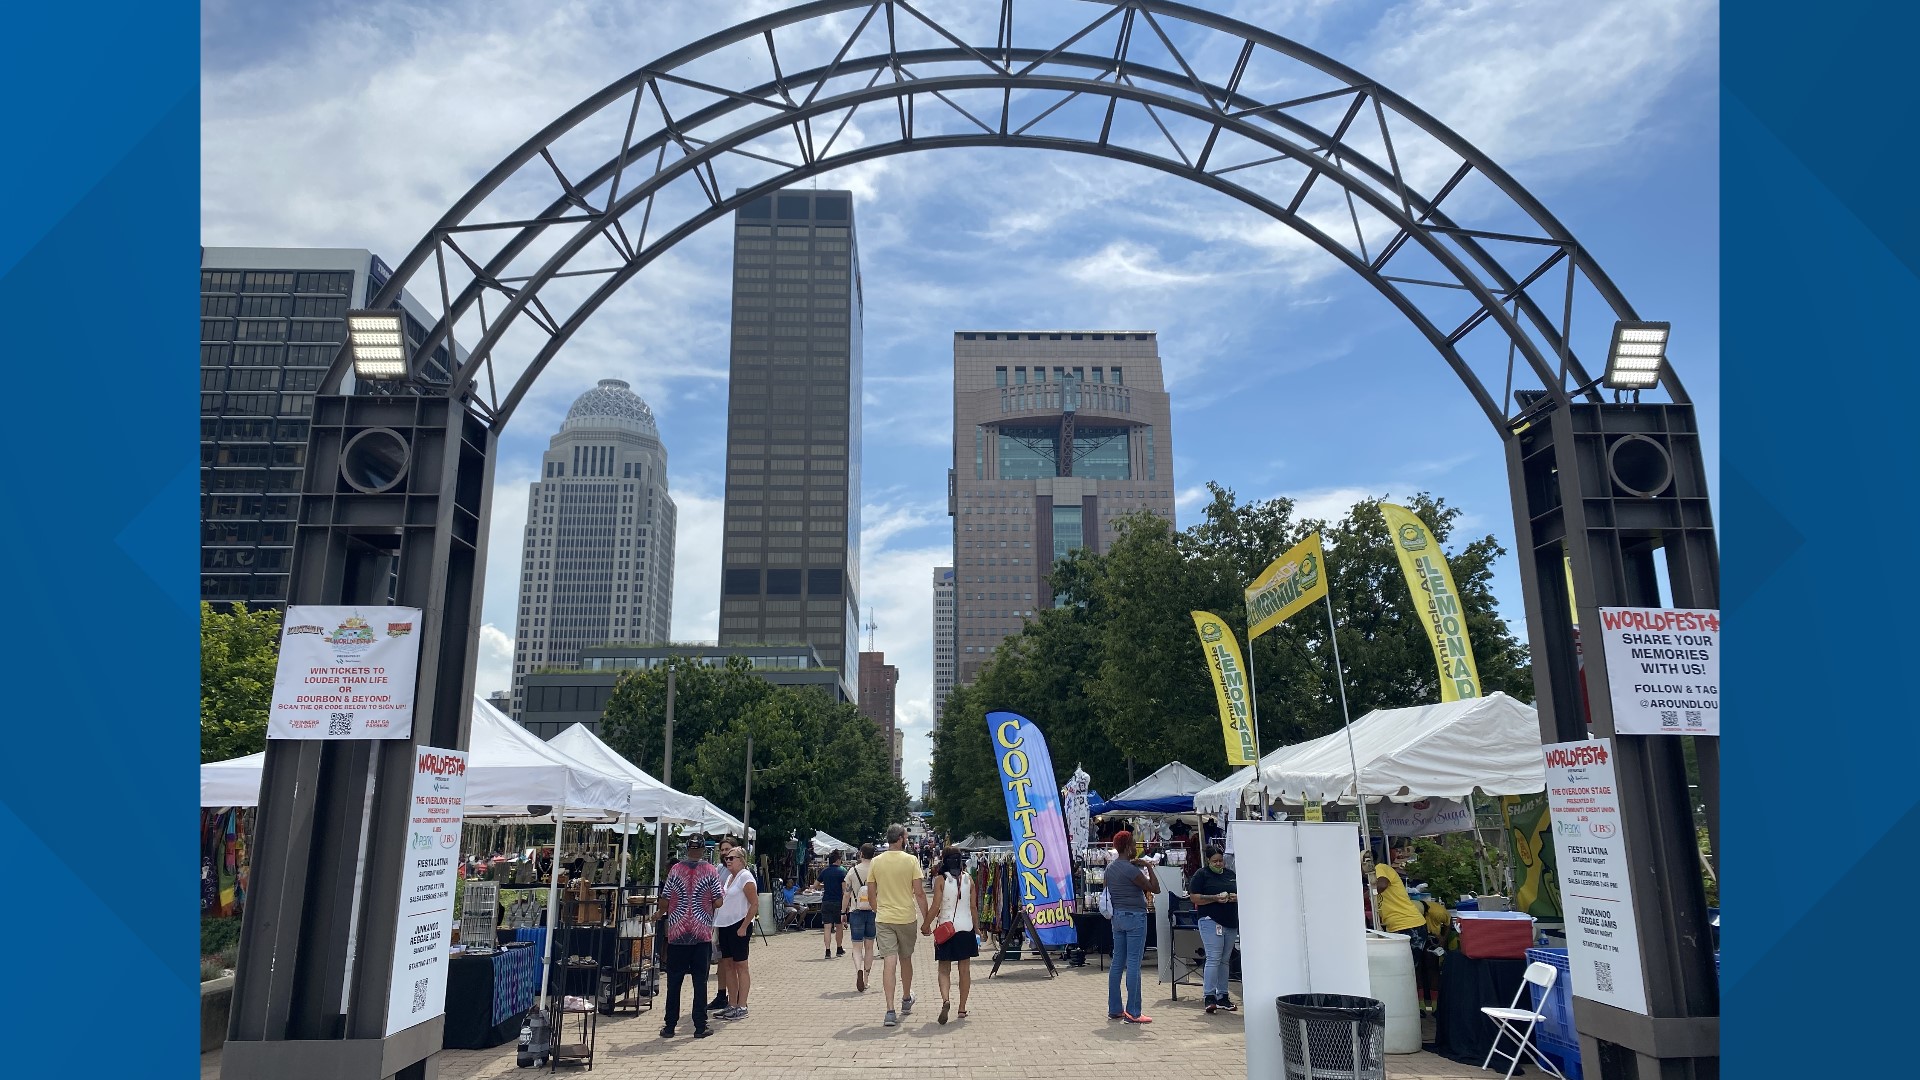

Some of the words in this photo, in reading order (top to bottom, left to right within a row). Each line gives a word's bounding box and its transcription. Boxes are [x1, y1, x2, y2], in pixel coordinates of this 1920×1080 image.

[1602, 610, 1706, 632] WORLDFEST
[1622, 633, 1672, 645] SHARE
[1674, 634, 1714, 646] YOUR
[1631, 648, 1709, 660] MEMORIES
[310, 667, 328, 675] WIN
[329, 667, 370, 675] TICKETS
[372, 667, 385, 675] TO
[1641, 662, 1679, 674] WITH
[1681, 663, 1706, 675] US!
[304, 676, 340, 684] LOUDER
[342, 676, 367, 684] THAN
[369, 676, 388, 684] LIFE
[1634, 684, 1683, 693] FOLLOW
[1686, 685, 1693, 694] &
[1695, 685, 1718, 694] TAG
[296, 695, 342, 703] BOURBON
[351, 695, 391, 703] BEYOND!
[1217, 644, 1256, 761] LEMONADE
[1545, 745, 1599, 768] WORLDFEST
[418, 753, 460, 776] WORLDFEST
[1562, 787, 1590, 795] OVERLOOK
[1591, 786, 1611, 795] STAGE
[416, 796, 425, 805] THE
[425, 797, 448, 805] OVERLOOK
[997, 719, 1049, 900] COTTON
[1507, 800, 1535, 816] SHAKE
[1593, 824, 1611, 832] JBS
[442, 834, 455, 843] JBS
[1567, 845, 1587, 855] FIESTA
[1587, 847, 1609, 855] LATINA
[417, 858, 433, 868] FIESTA
[1573, 869, 1592, 877] STARTING
[1580, 879, 1599, 887] LESSONS
[1025, 899, 1074, 928] Candy
[1581, 907, 1611, 919] JUNKANOO
[414, 921, 439, 935] JUNKANOO
[1577, 916, 1600, 927] REGGAE
[1600, 919, 1618, 929] JAMS
[410, 932, 429, 945] REGGAE
[430, 930, 441, 940] JAMS
[1583, 927, 1600, 936] SUNDAY
[1600, 930, 1613, 938] NIGHT
[1582, 940, 1602, 950] STARTING
